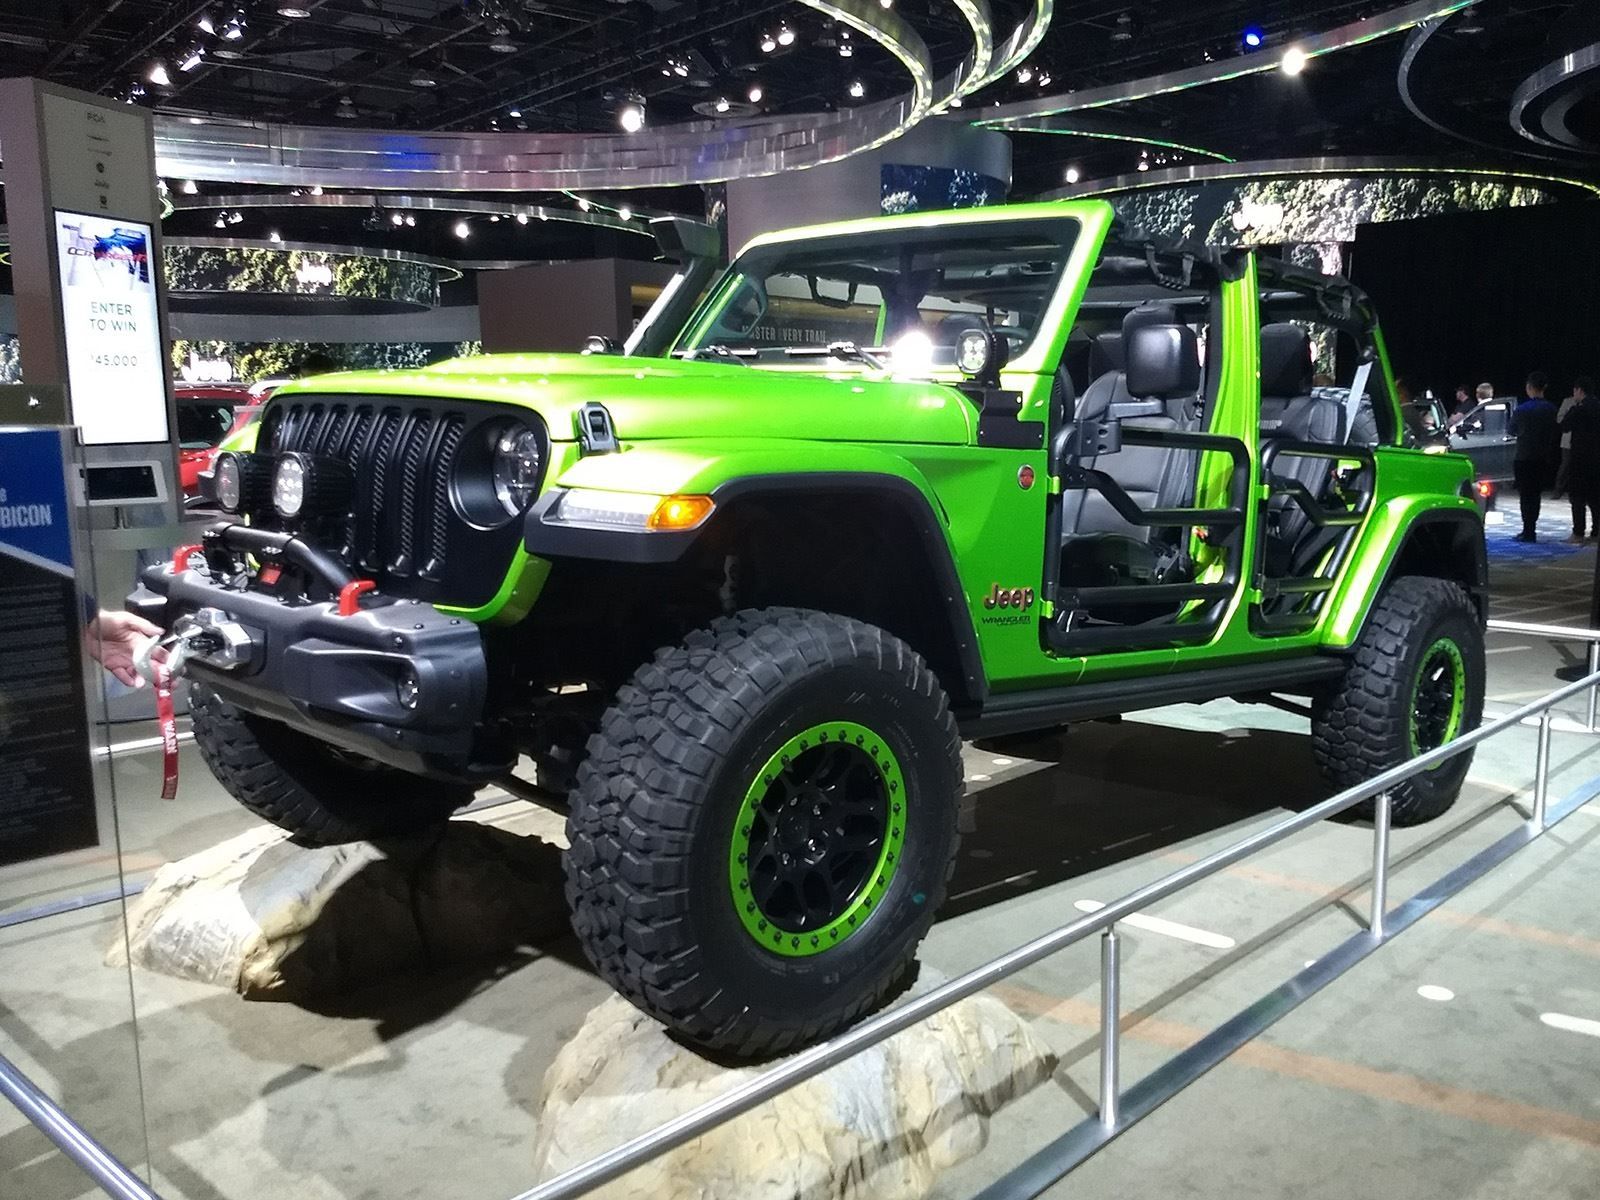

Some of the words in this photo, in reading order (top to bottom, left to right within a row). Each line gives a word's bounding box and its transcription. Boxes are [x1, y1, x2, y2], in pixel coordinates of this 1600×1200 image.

[91, 301, 132, 316] ENTER
[89, 318, 107, 331] TO
[110, 320, 137, 332] WIN
[777, 327, 802, 342] VERY
[983, 582, 1034, 612] Jeep
[981, 615, 1031, 625] WRANGLER
[164, 720, 177, 754] WARN
